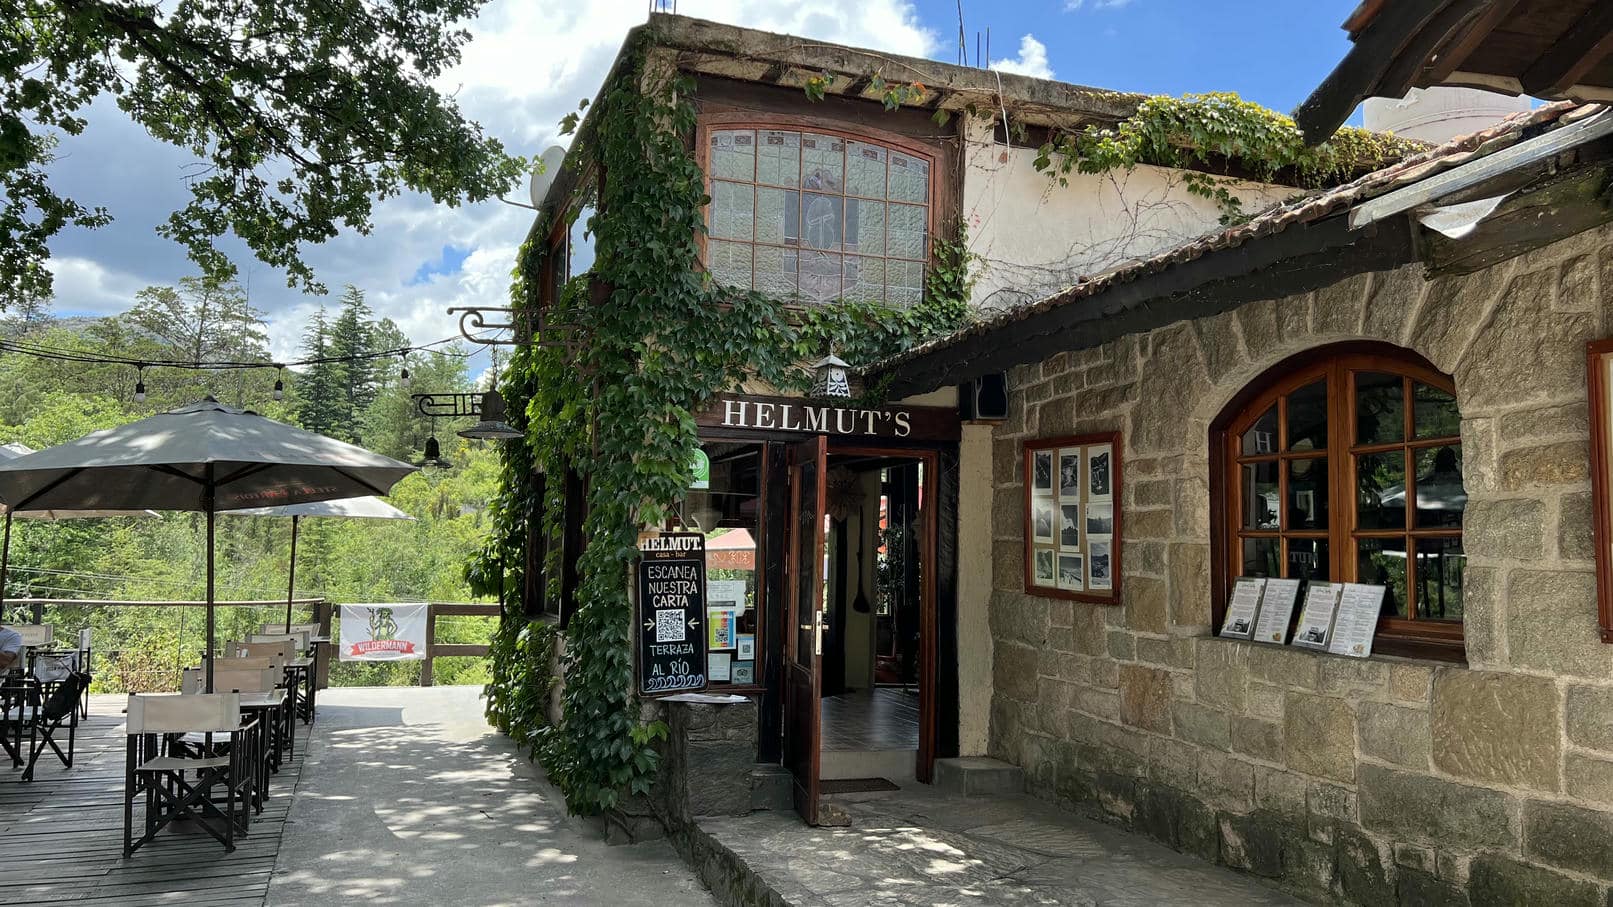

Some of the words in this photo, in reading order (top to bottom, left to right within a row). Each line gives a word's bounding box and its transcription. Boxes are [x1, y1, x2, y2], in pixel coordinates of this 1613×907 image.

[721, 400, 911, 437] HELMUT'S
[647, 565, 698, 580] ESCANEA
[648, 581, 698, 594] NUESTRA
[652, 595, 689, 607] CARTA
[358, 640, 408, 652] WILDERMANN
[649, 643, 694, 657] TERRAZA
[652, 663, 665, 676] AL
[669, 657, 690, 675] RÍO
